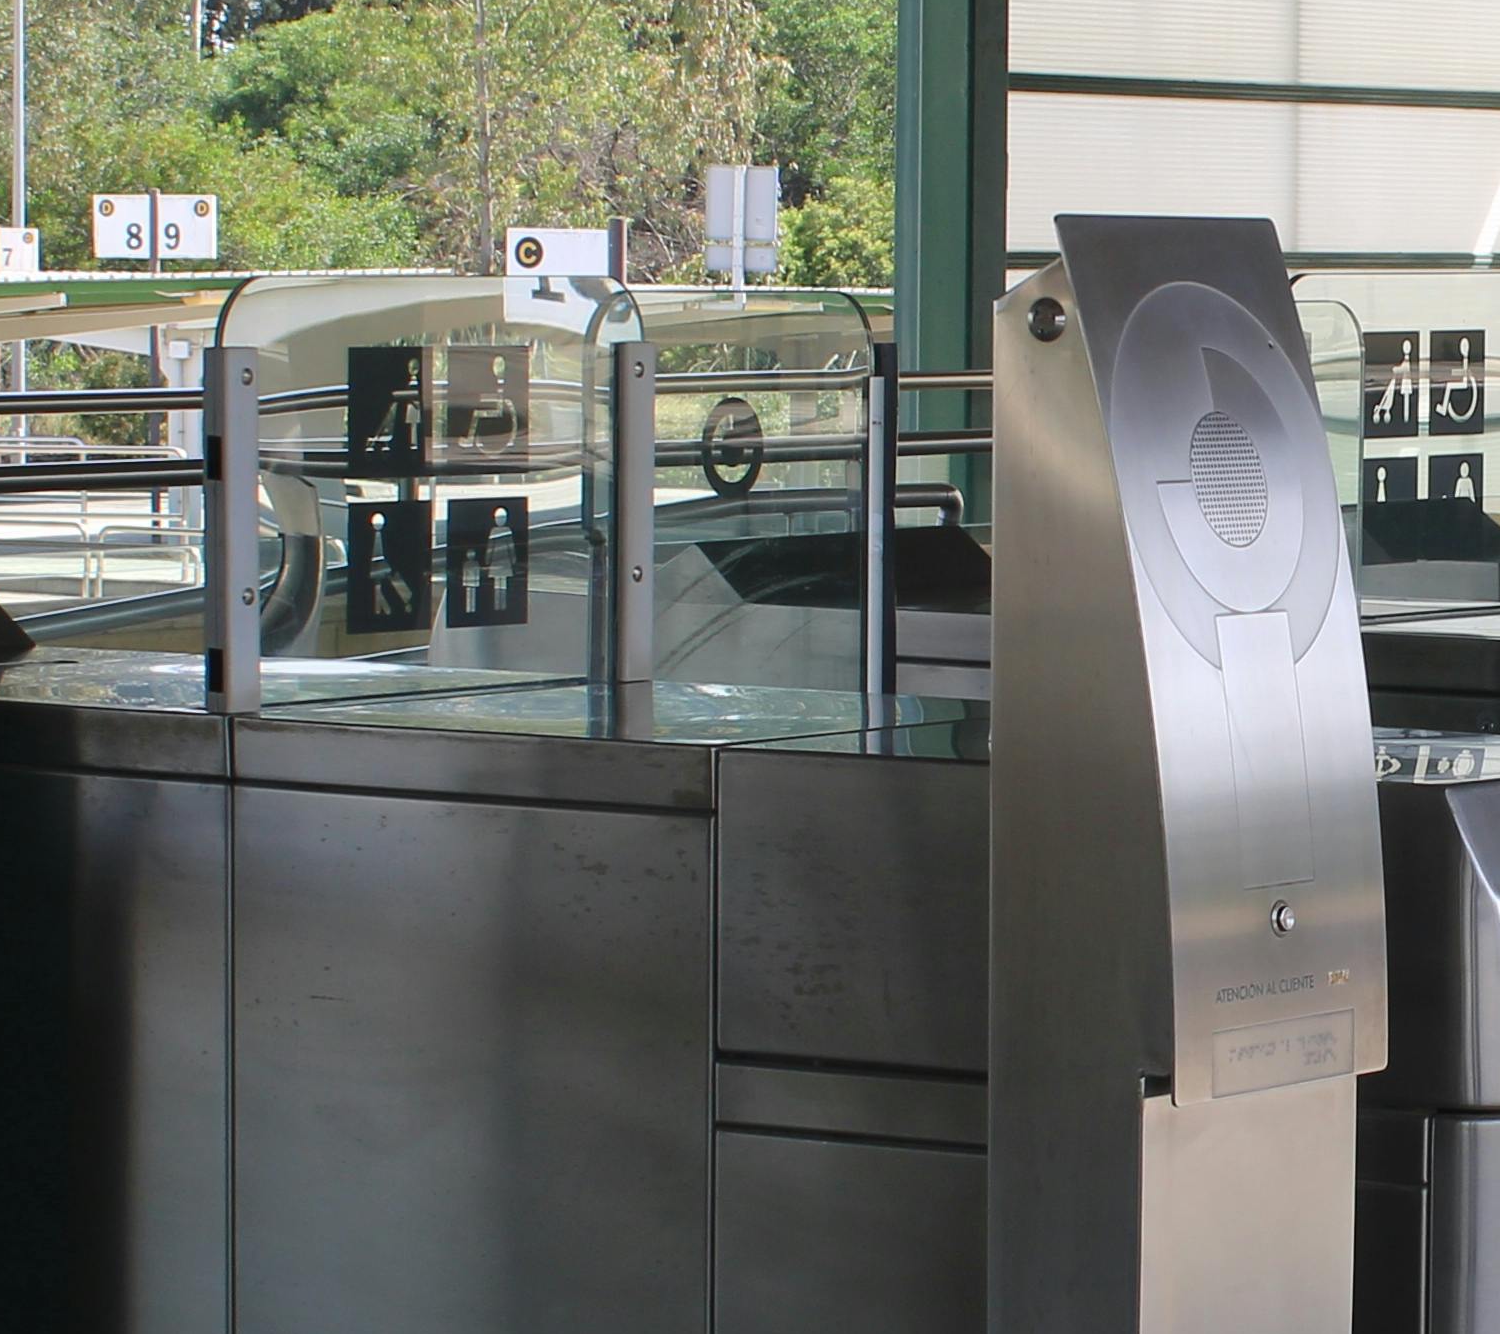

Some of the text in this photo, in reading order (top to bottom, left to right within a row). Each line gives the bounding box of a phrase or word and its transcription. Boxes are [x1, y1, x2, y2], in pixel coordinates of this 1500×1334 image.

[126, 223, 143, 249] 8
[164, 223, 181, 249] 9
[2, 248, 13, 266] 7
[518, 240, 538, 265] C
[1266, 982, 1277, 995] AL
[1279, 974, 1315, 994] CLIENTE
